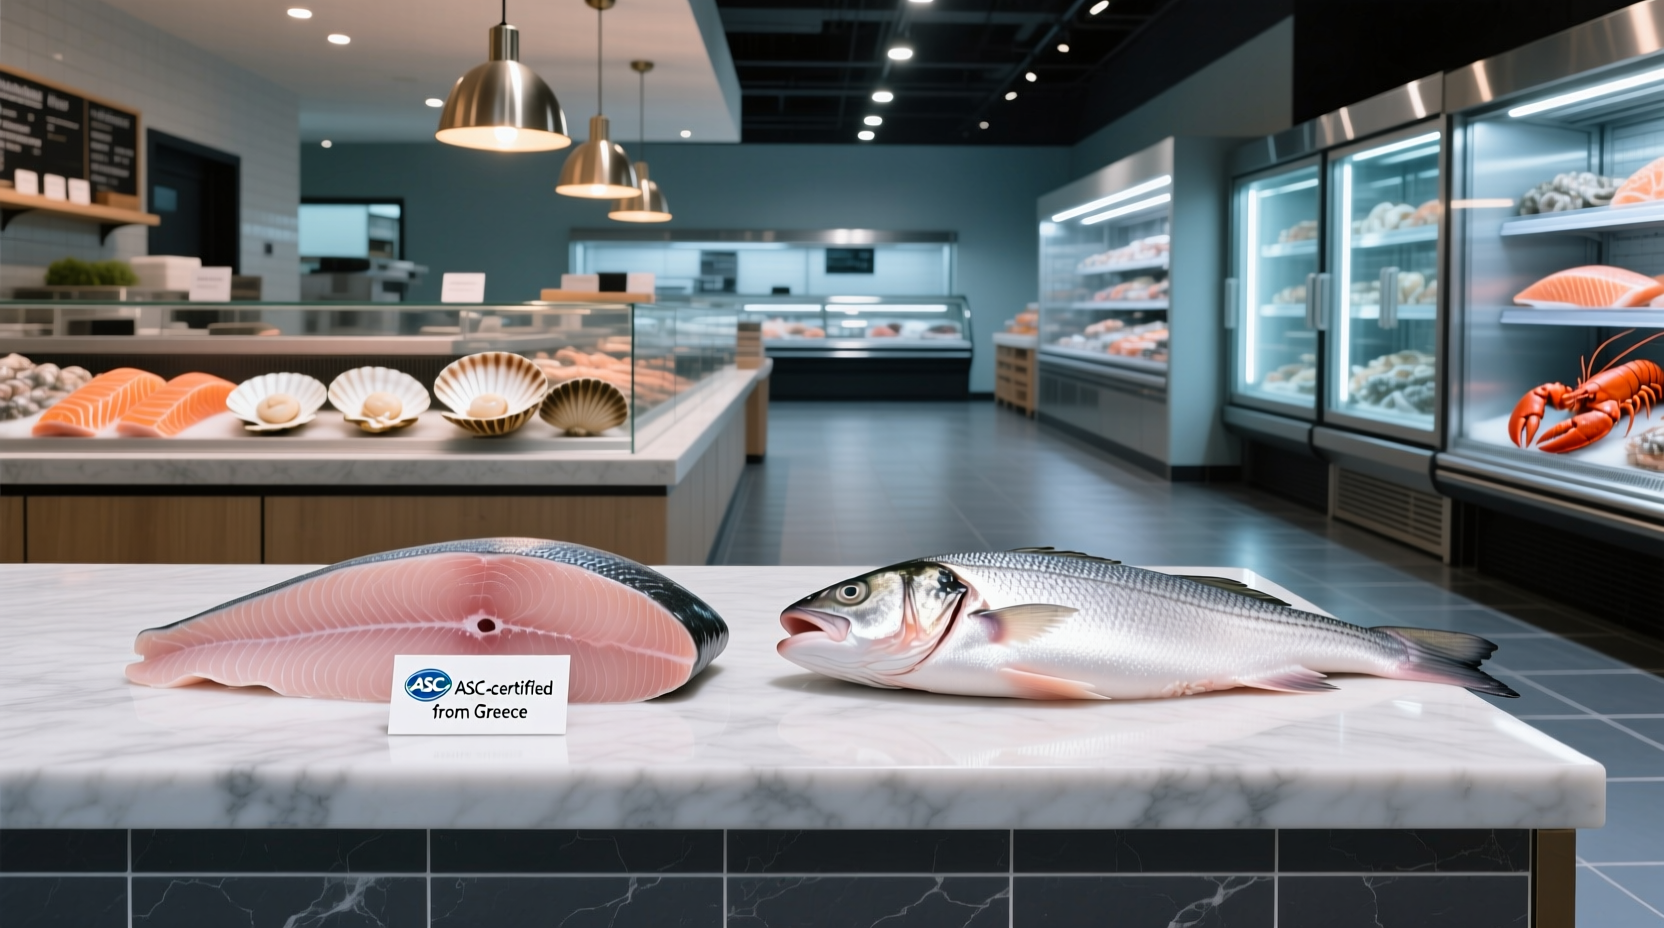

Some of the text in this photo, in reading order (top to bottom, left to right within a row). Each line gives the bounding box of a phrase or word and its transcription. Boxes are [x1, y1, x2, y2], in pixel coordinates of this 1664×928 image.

[409, 677, 553, 696] ASC ASC-certified
[432, 704, 528, 719] from Greece
